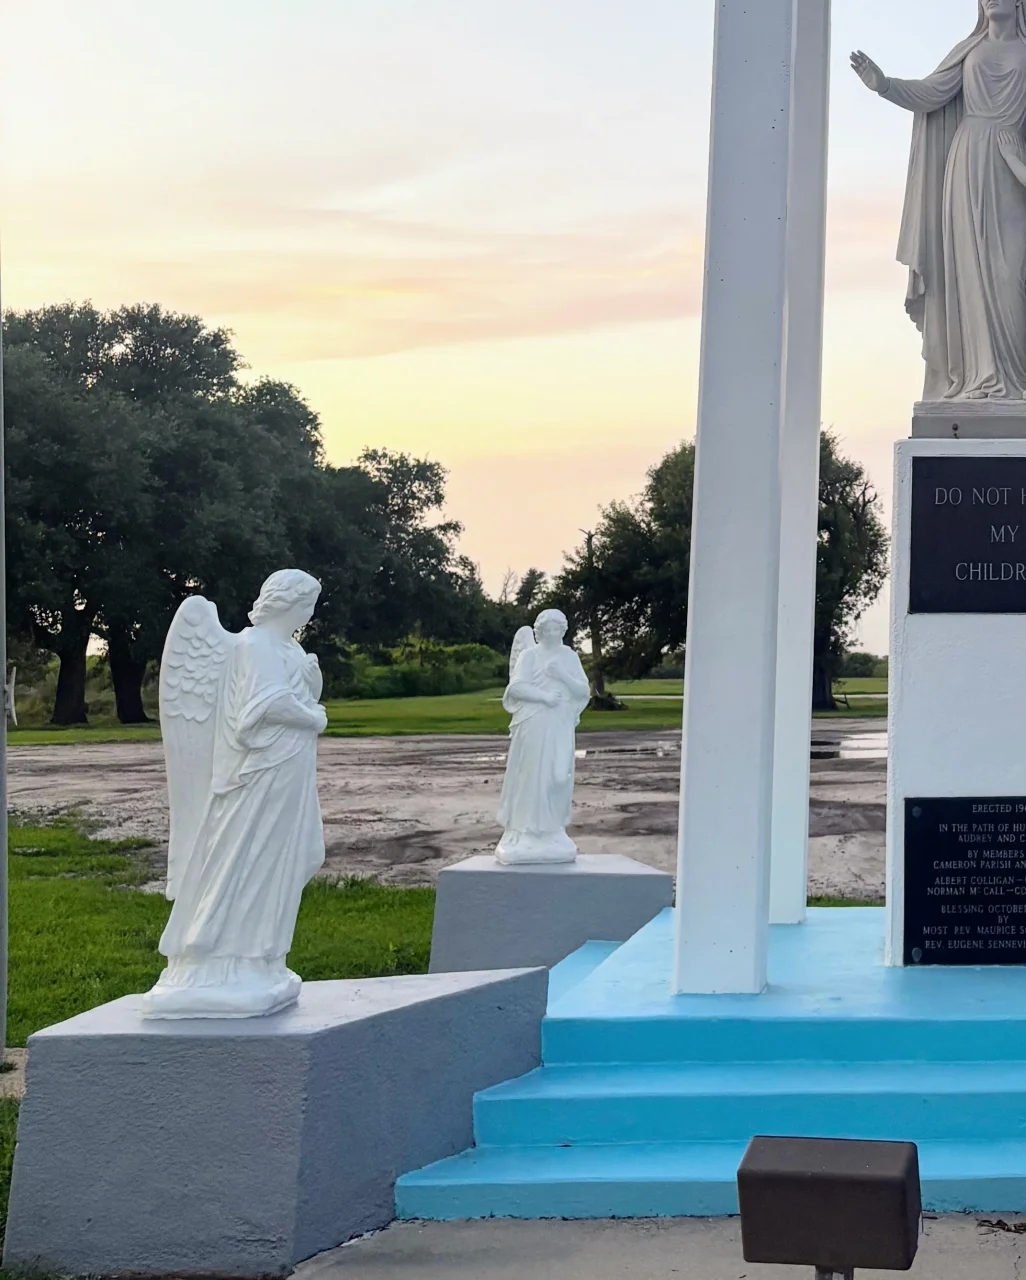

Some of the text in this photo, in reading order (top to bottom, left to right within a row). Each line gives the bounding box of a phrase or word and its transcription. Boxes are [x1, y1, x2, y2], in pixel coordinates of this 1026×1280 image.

[934, 487, 962, 505] DO
[972, 487, 1012, 506] NOT
[990, 525, 1019, 543] MY
[972, 804, 1012, 813] ERECTED
[938, 823, 948, 832] IN
[951, 823, 969, 832] THE
[972, 823, 995, 832] PATH
[997, 823, 1009, 832] OF
[957, 834, 993, 843] AUDREY
[996, 834, 1016, 843] AND
[967, 849, 979, 859] BY
[982, 849, 1025, 859] MEMBERS
[933, 860, 977, 869] CAMERON
[980, 860, 1011, 869] PARISH
[934, 876, 967, 885] ALBERT
[927, 886, 965, 896] NORMAN
[941, 904, 984, 914] BLESSING
[997, 915, 1009, 924] BY
[922, 925, 948, 935] MOST
[977, 925, 1016, 935] MAURICE
[948, 940, 984, 949] EUGENE
